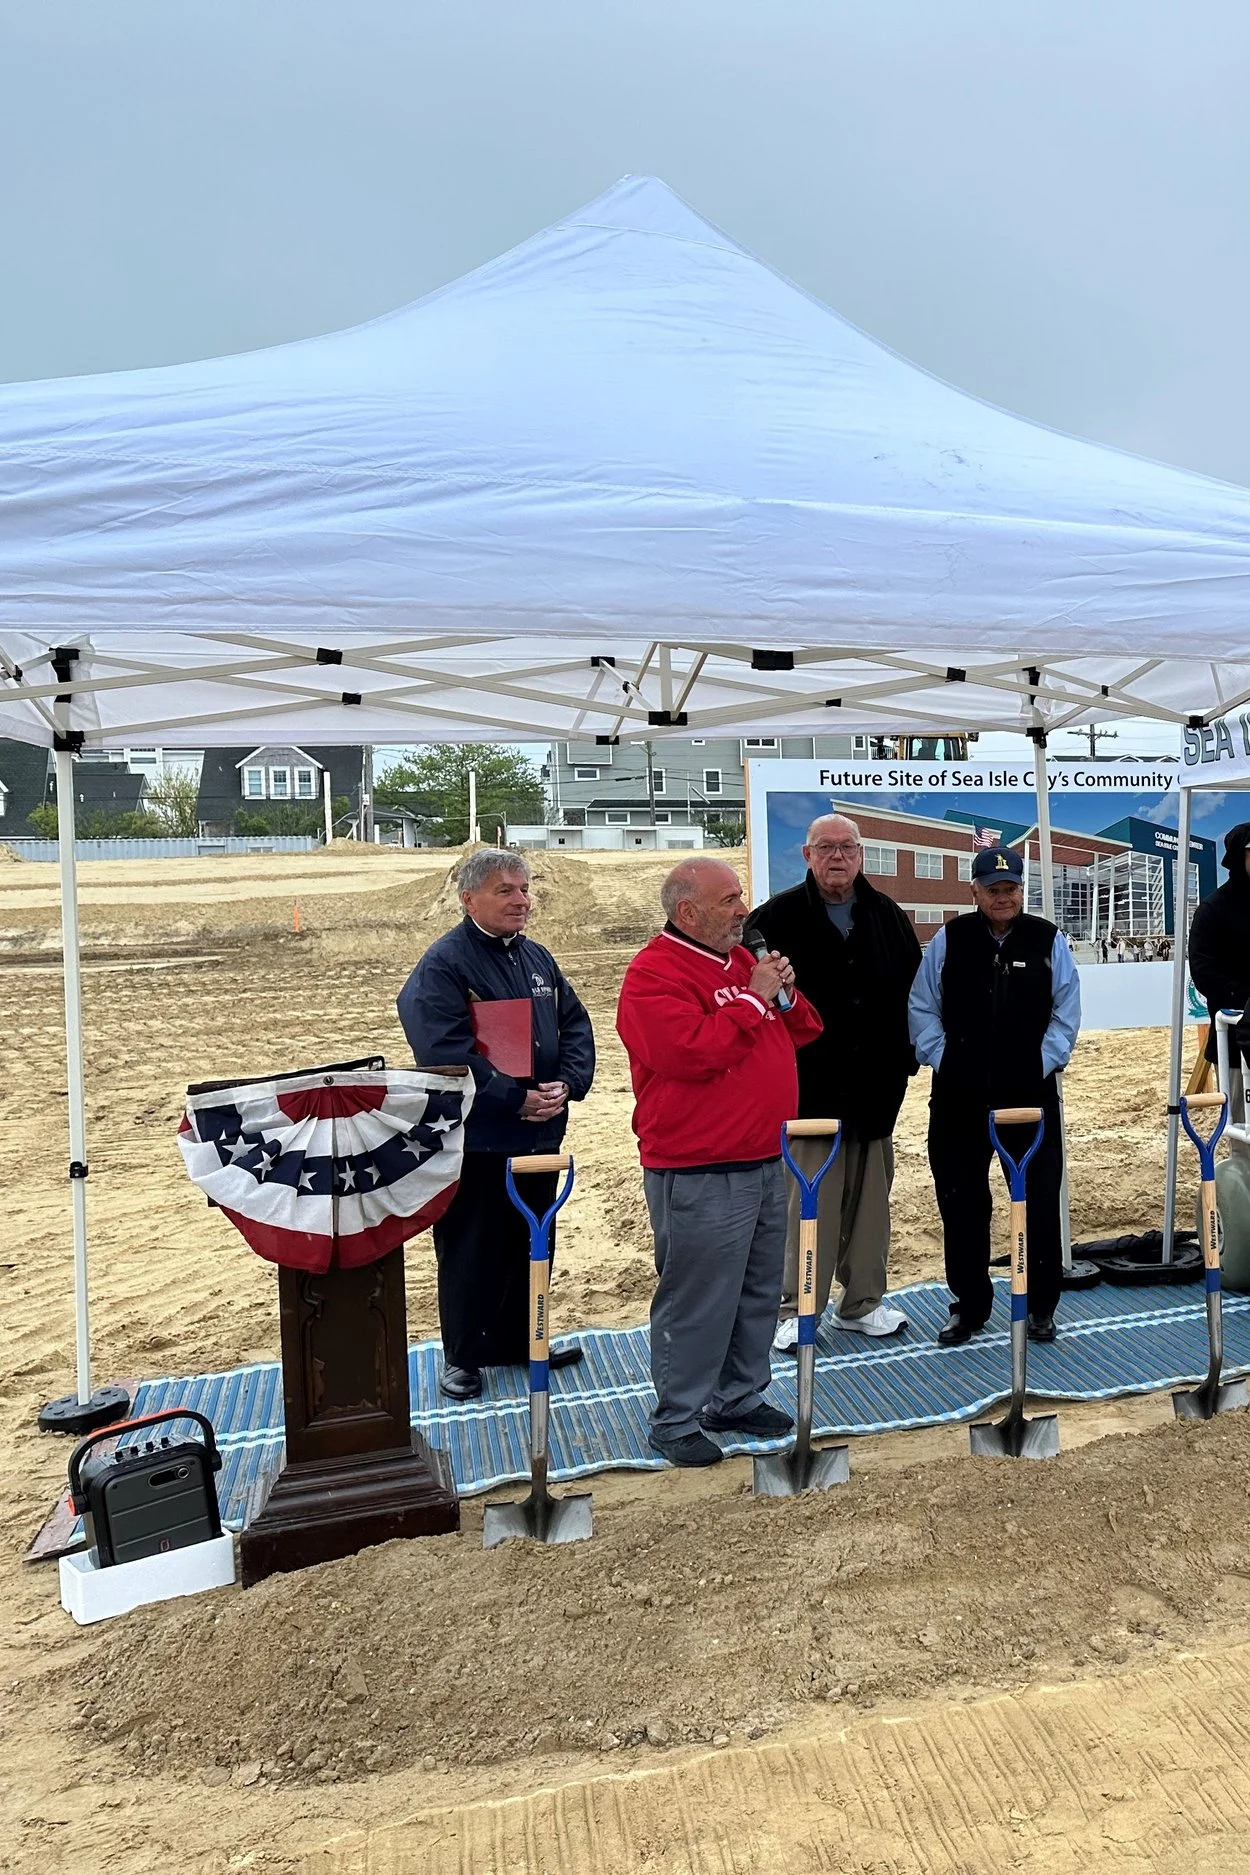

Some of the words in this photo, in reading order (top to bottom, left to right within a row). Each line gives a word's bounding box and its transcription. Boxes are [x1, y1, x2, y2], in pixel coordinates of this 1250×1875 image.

[1183, 717, 1235, 766] SEA
[819, 769, 883, 787] Future
[888, 769, 924, 787] Site
[928, 769, 948, 787] of
[951, 770, 983, 787] Sea
[989, 770, 1019, 787] Isle
[1023, 770, 1069, 791] Cy's
[1073, 771, 1173, 791] Community
[1209, 1210, 1217, 1250] WESTWARD
[803, 1249, 813, 1295] WESTWARD
[1016, 1231, 1025, 1274] WESTWARD
[535, 1293, 545, 1341] WESTWARD
